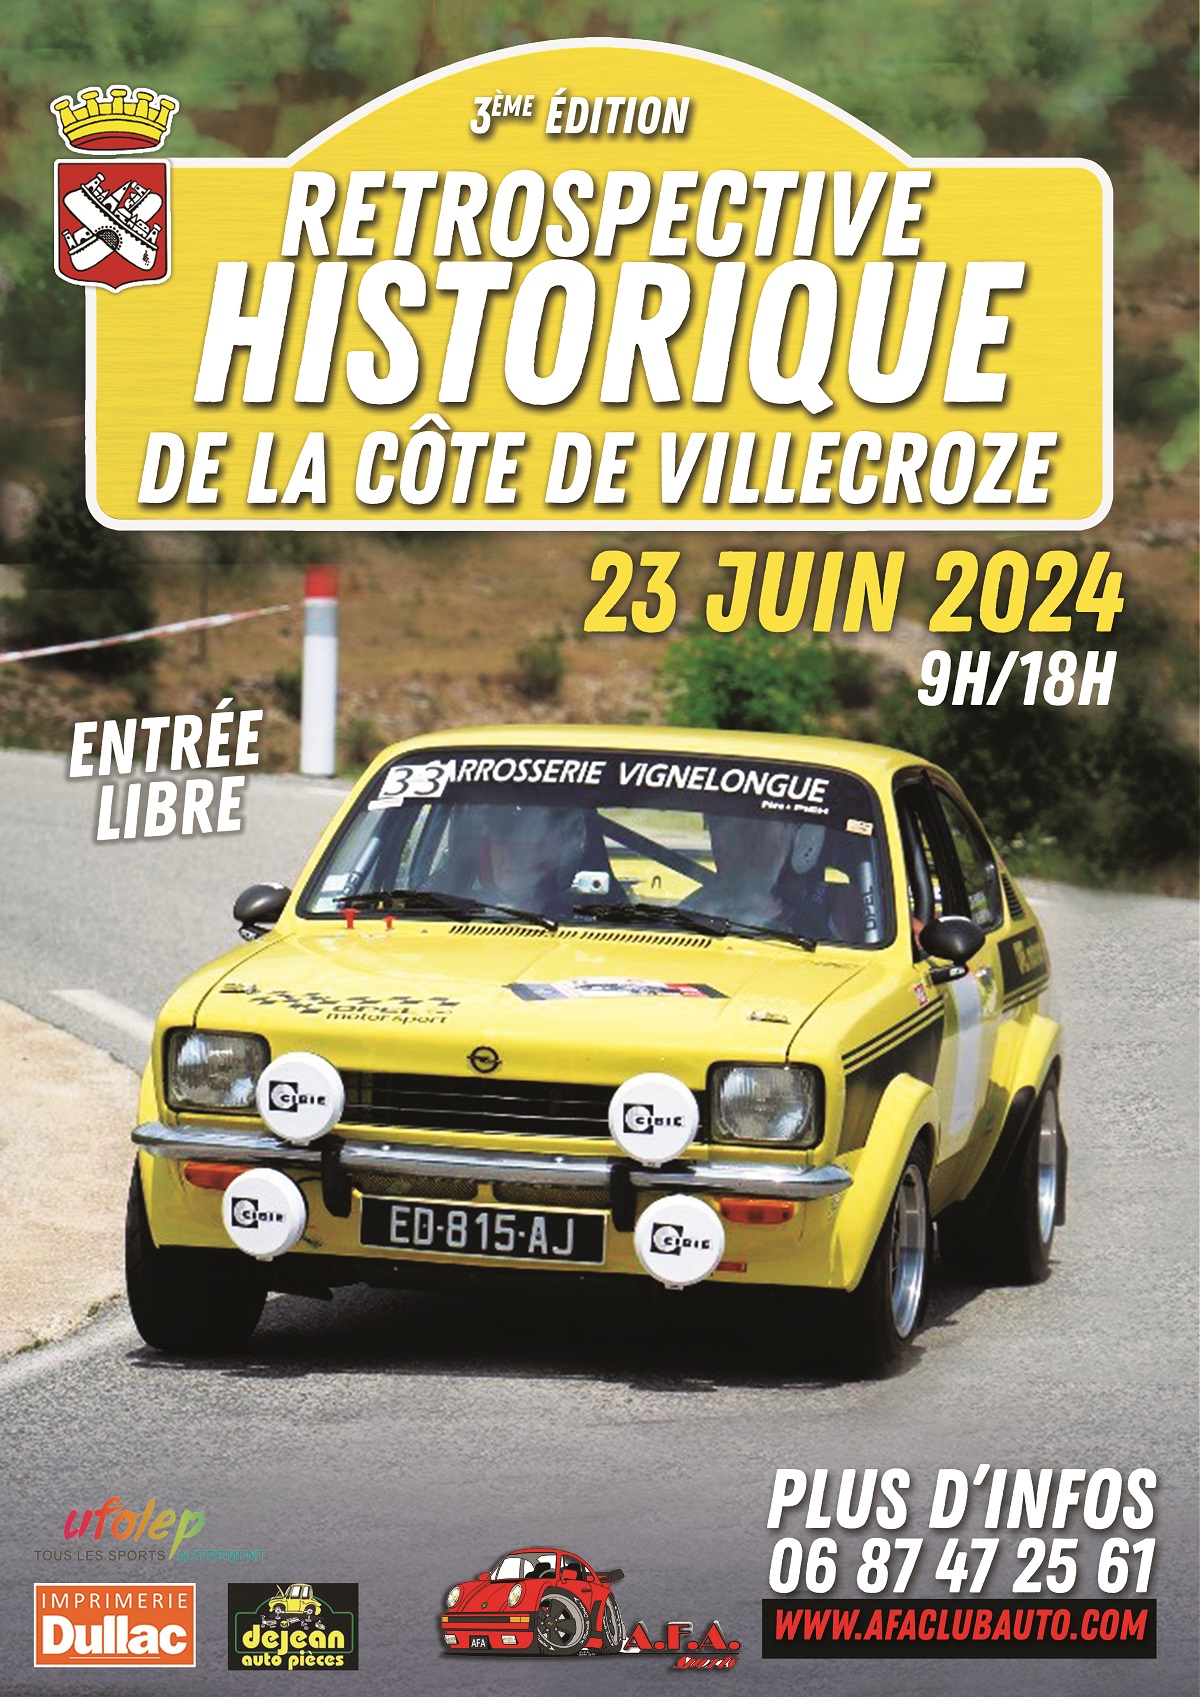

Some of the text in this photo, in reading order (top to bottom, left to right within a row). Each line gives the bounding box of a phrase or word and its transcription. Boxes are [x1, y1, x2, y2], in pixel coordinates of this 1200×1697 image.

[470, 87, 690, 134] 3ÈME ÉDITION
[281, 171, 931, 258] RETROSPECTIVE
[194, 259, 1025, 415] HISTORIQUE
[137, 413, 1057, 505] DE LA CÔTE DE VILLECROZE
[583, 550, 1125, 633] 23 JUIN 2024
[917, 649, 1118, 707] 9H/18H
[69, 697, 263, 778] ENTRÉE
[382, 766, 446, 796] 33
[440, 757, 829, 803] ARROSSERIE VIGNELONGUE
[96, 775, 245, 841] LIBRE
[326, 1012, 448, 1025] motorsport
[389, 1204, 575, 1256] ED-815-AJ
[766, 1463, 1157, 1530] PLUS D'INFOS
[63, 1496, 206, 1560] ufolep
[34, 1550, 266, 1562] TOUS LES SPORTS AUTREMENT
[769, 1537, 1156, 1594] 06 87 47 25 61
[41, 1592, 188, 1609] IMPRIMERIE
[42, 1615, 188, 1655] Dullac
[242, 1624, 345, 1656] dejean
[470, 1638, 487, 1649] AFA
[623, 1620, 741, 1651] A.F.A.
[775, 1608, 1149, 1641] WWW.AFACLUBAUTO.COM
[241, 1649, 345, 1671] auto pièces
